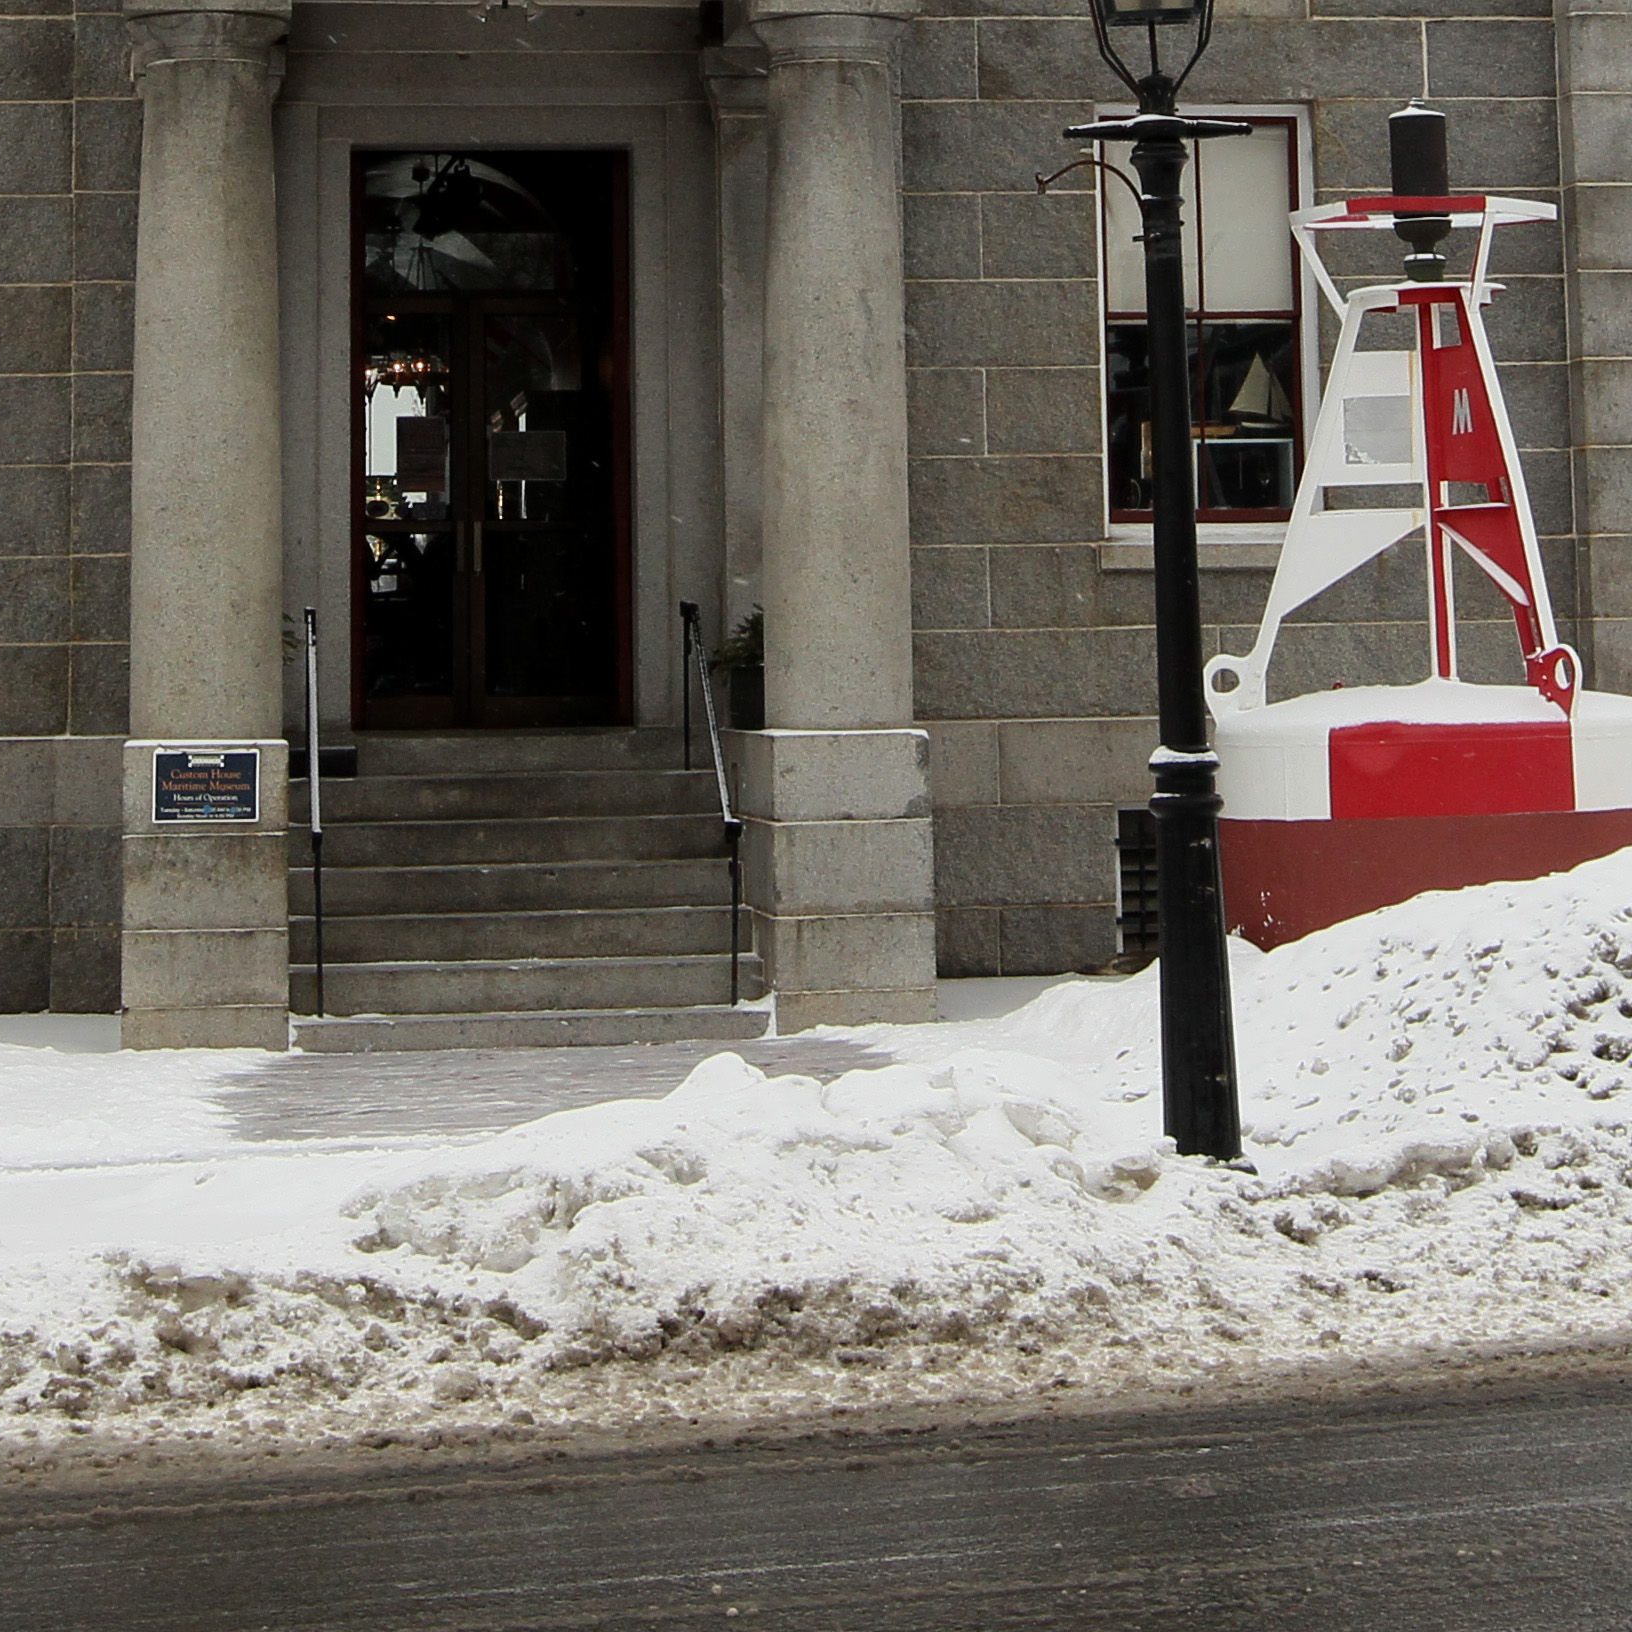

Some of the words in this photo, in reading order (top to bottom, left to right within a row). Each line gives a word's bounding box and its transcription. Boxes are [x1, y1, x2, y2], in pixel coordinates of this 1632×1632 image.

[170, 769, 208, 779] Custom
[211, 769, 241, 779] House
[162, 781, 207, 791] Maritime
[209, 781, 250, 791] Museum
[173, 793, 194, 801] Hours
